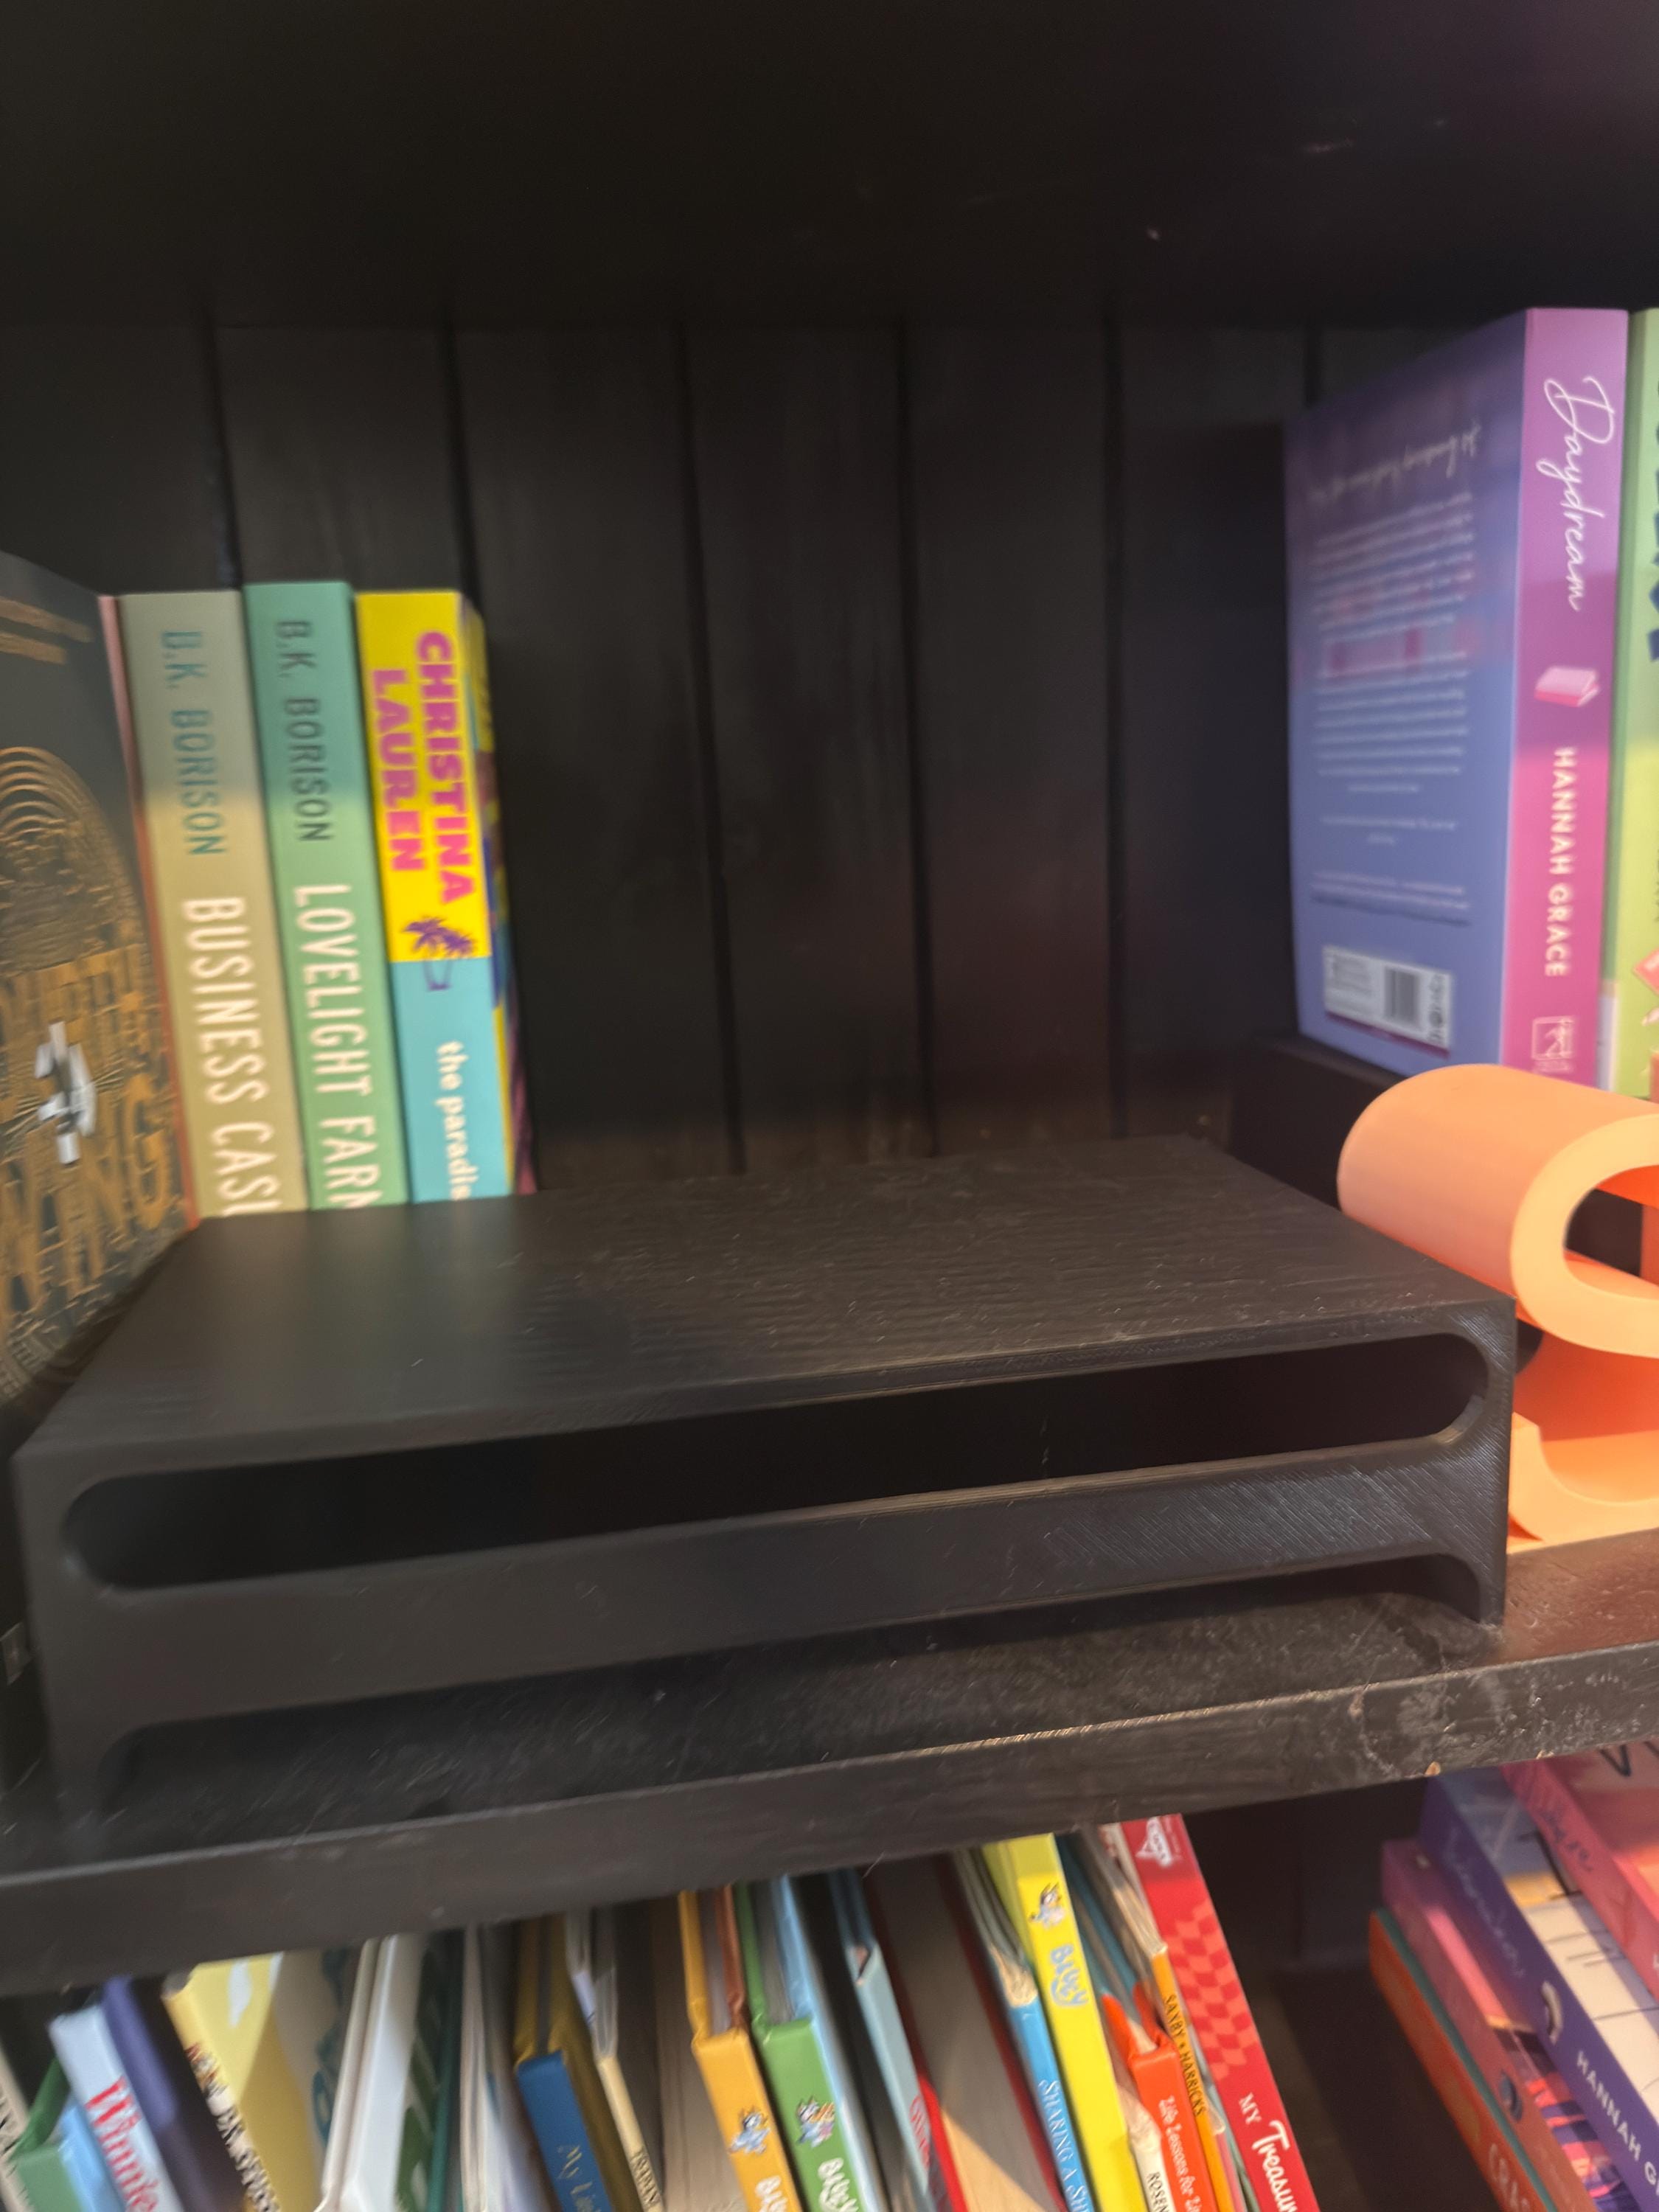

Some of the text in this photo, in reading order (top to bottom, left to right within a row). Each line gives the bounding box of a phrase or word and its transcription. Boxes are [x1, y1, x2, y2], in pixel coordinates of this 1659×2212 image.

[1535, 375, 1615, 612] Daydream
[161, 630, 226, 857] B.K. BORISON
[274, 618, 334, 843] B.K. BORISON
[372, 668, 425, 872] LAUREN
[415, 630, 479, 905] CHRISTINA
[1545, 746, 1578, 978] HANNAH GRACE
[180, 897, 271, 1106] BUSINESS
[293, 884, 375, 1096] LOVELIGHT
[437, 1040, 466, 1091] the
[1038, 2079, 1074, 2163] SHARING
[1062, 2168, 1078, 2183] A
[1180, 2176, 1196, 2197] for
[1239, 2092, 1262, 2125] MY
[1576, 2050, 1642, 2162] HANNAH
